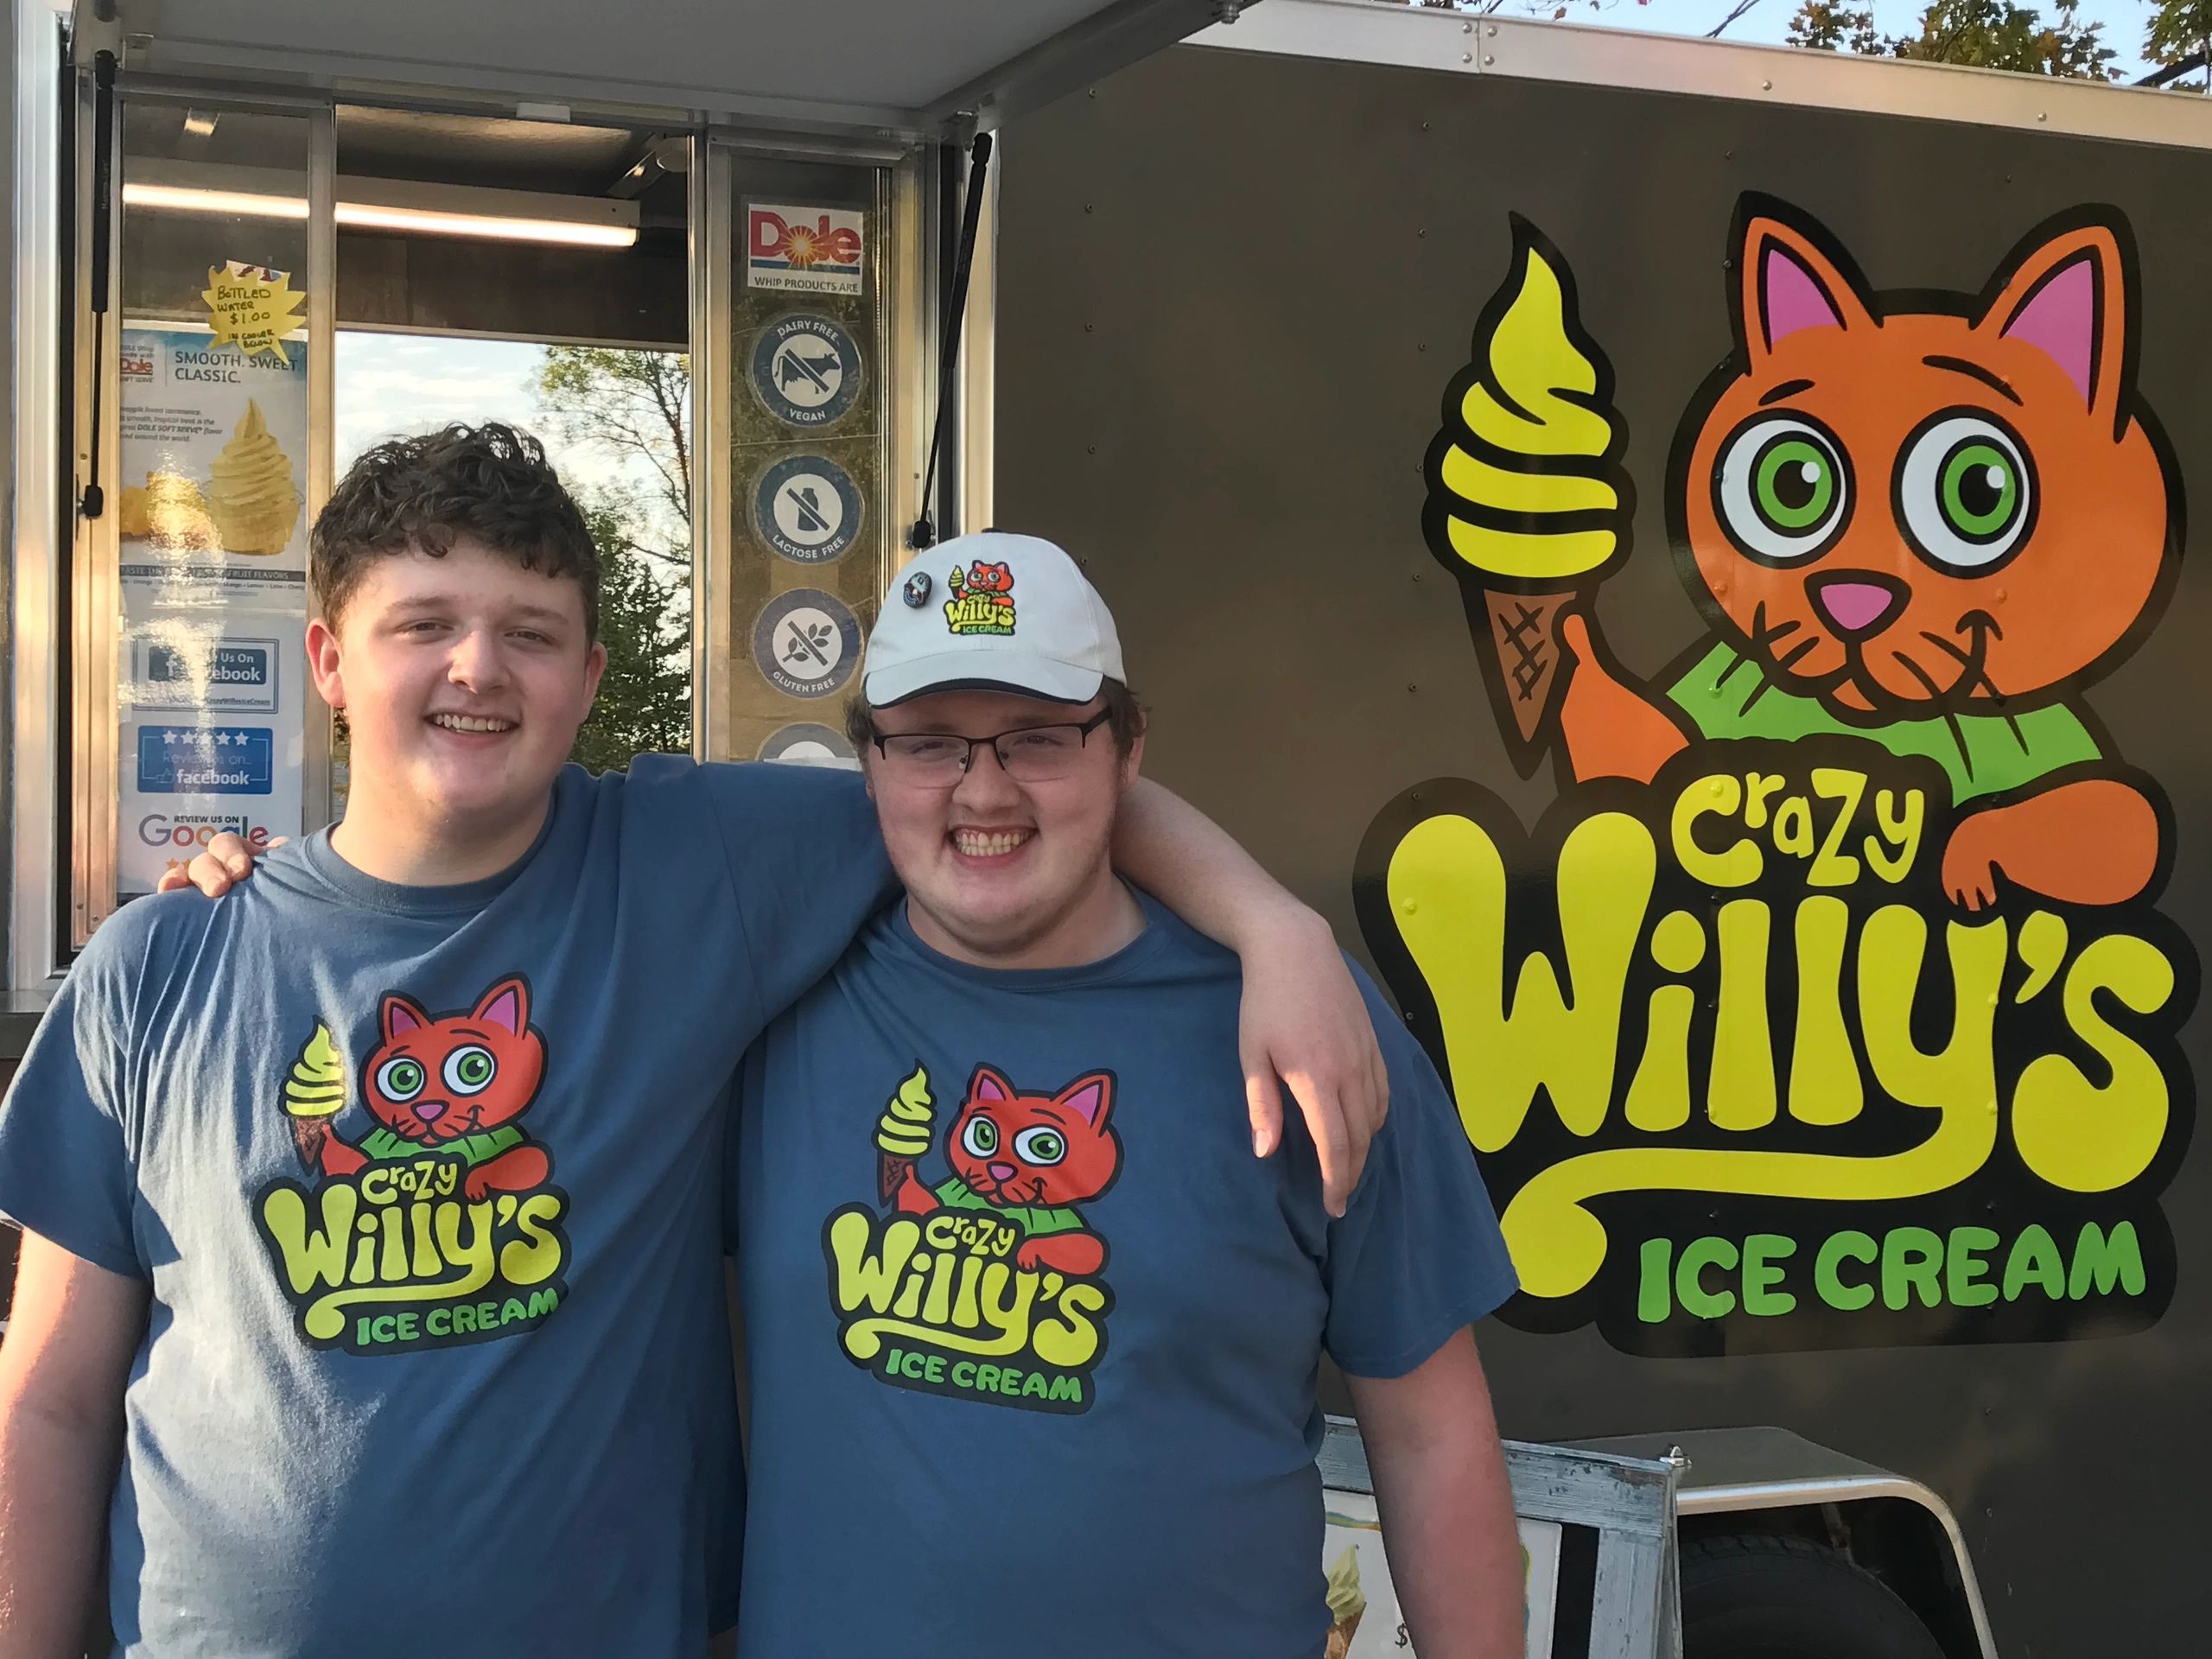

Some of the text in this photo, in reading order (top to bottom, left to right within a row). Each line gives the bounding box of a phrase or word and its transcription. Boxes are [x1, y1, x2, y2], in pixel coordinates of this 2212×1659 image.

[751, 211, 861, 264] Dole
[217, 285, 271, 300] BOTTLED
[754, 276, 858, 292] WHIP PRODUCTS ARE
[217, 301, 255, 312] WATER
[230, 312, 270, 325] $1.00
[241, 329, 275, 340] COOLER
[777, 321, 838, 341] DAIRY FREE
[243, 339, 273, 348] BELOW
[175, 351, 245, 367] SMOOTH.
[175, 367, 241, 383] CLASSIC.
[790, 408, 826, 422] VEGAN
[772, 534, 844, 558] LACTOSE FREE
[945, 600, 1014, 632] Willy's
[978, 626, 1012, 634] CREAM
[220, 652, 254, 663] Us On
[773, 671, 836, 692] GLUTEN FREE
[176, 769, 250, 785] facebook
[1670, 766, 1926, 888] Crazy
[1386, 810, 2175, 1298] Willy's
[360, 1160, 458, 1205] Crazy
[925, 1215, 1015, 1257] Crazy
[264, 1183, 562, 1339] Willy's
[1636, 1219, 2146, 1324] ICE CREAM
[830, 1211, 1105, 1367] Willy's
[357, 1287, 559, 1345] ICE CREAM
[885, 1348, 1083, 1403] ICE CREAM
